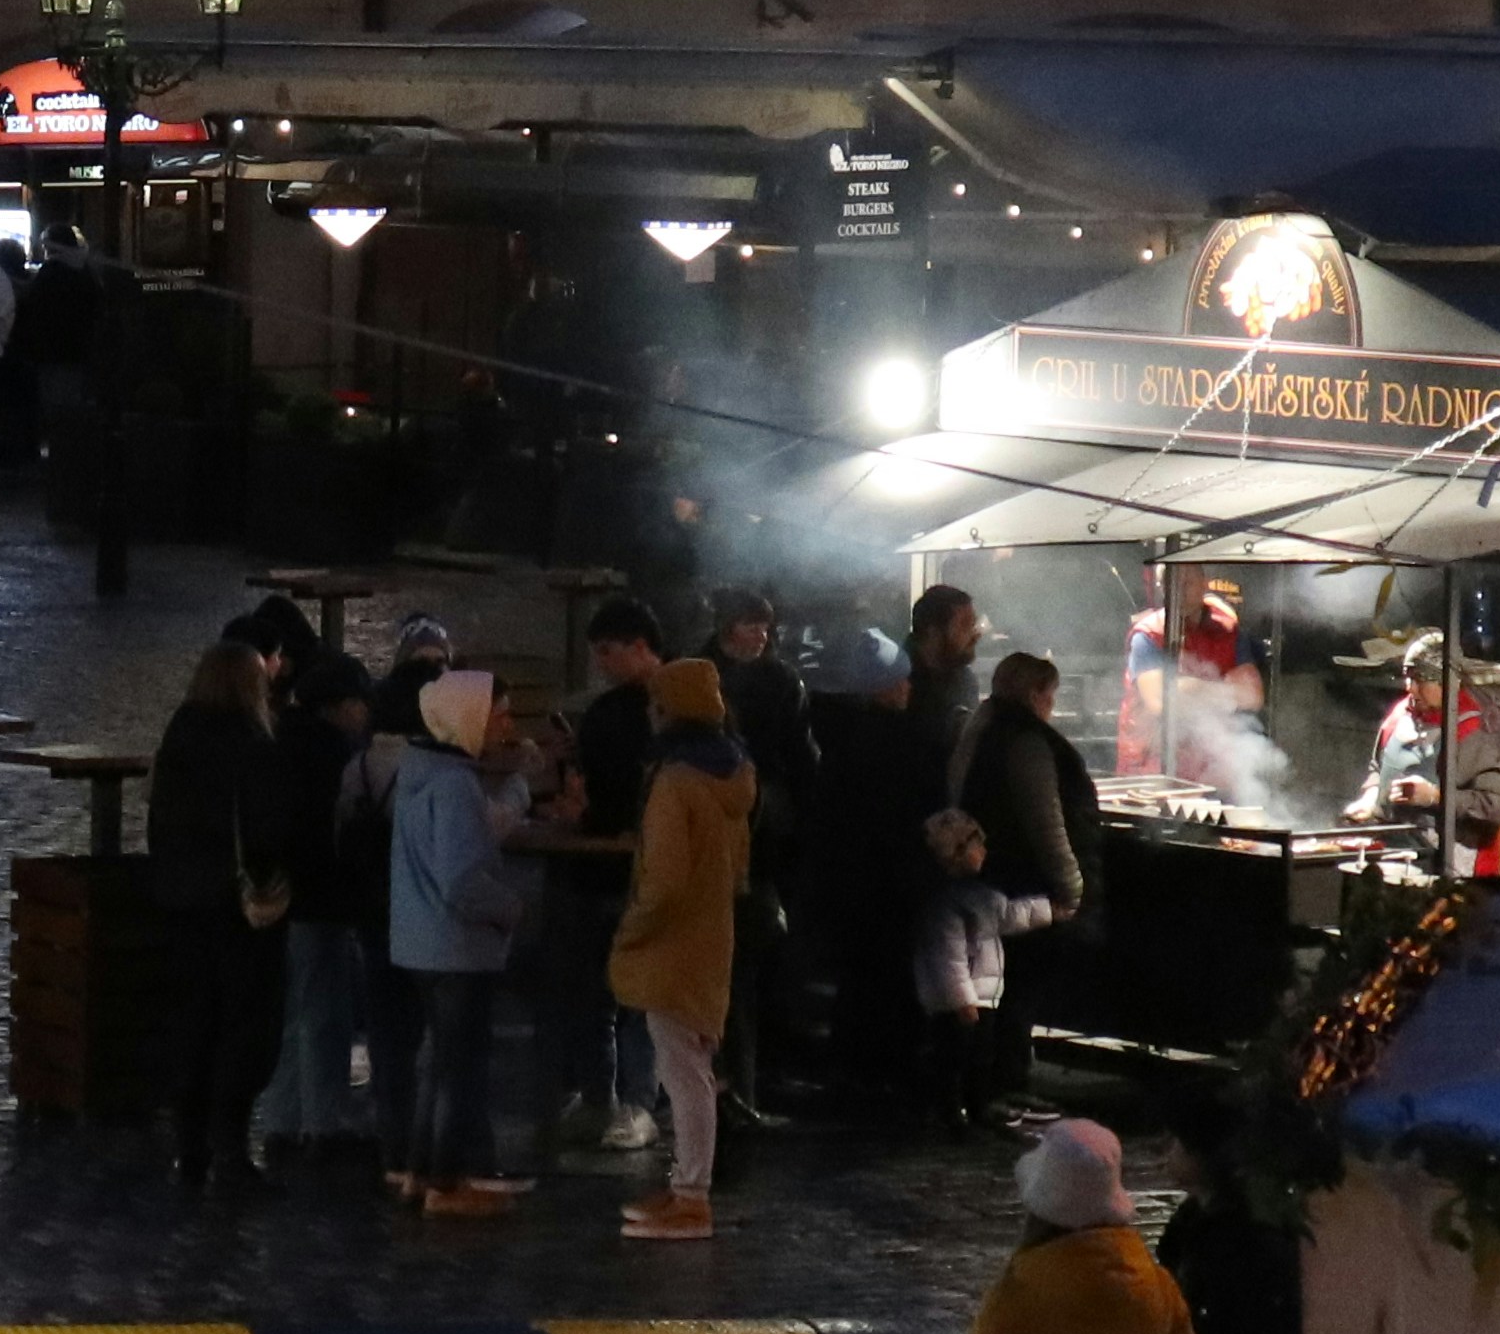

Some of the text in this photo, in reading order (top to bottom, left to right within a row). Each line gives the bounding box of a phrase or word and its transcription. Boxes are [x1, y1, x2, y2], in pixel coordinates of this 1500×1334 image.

[6, 116, 33, 133] EL
[35, 115, 90, 133] TORO
[848, 181, 890, 196] STEAKS
[843, 202, 894, 217] BURGERS
[837, 222, 900, 237] COCKTAILS
[1322, 260, 1346, 315] quality
[1032, 356, 1101, 402] GRIL
[1113, 364, 1127, 402] U
[1138, 360, 1370, 424] STAROMĚSTSKÉ
